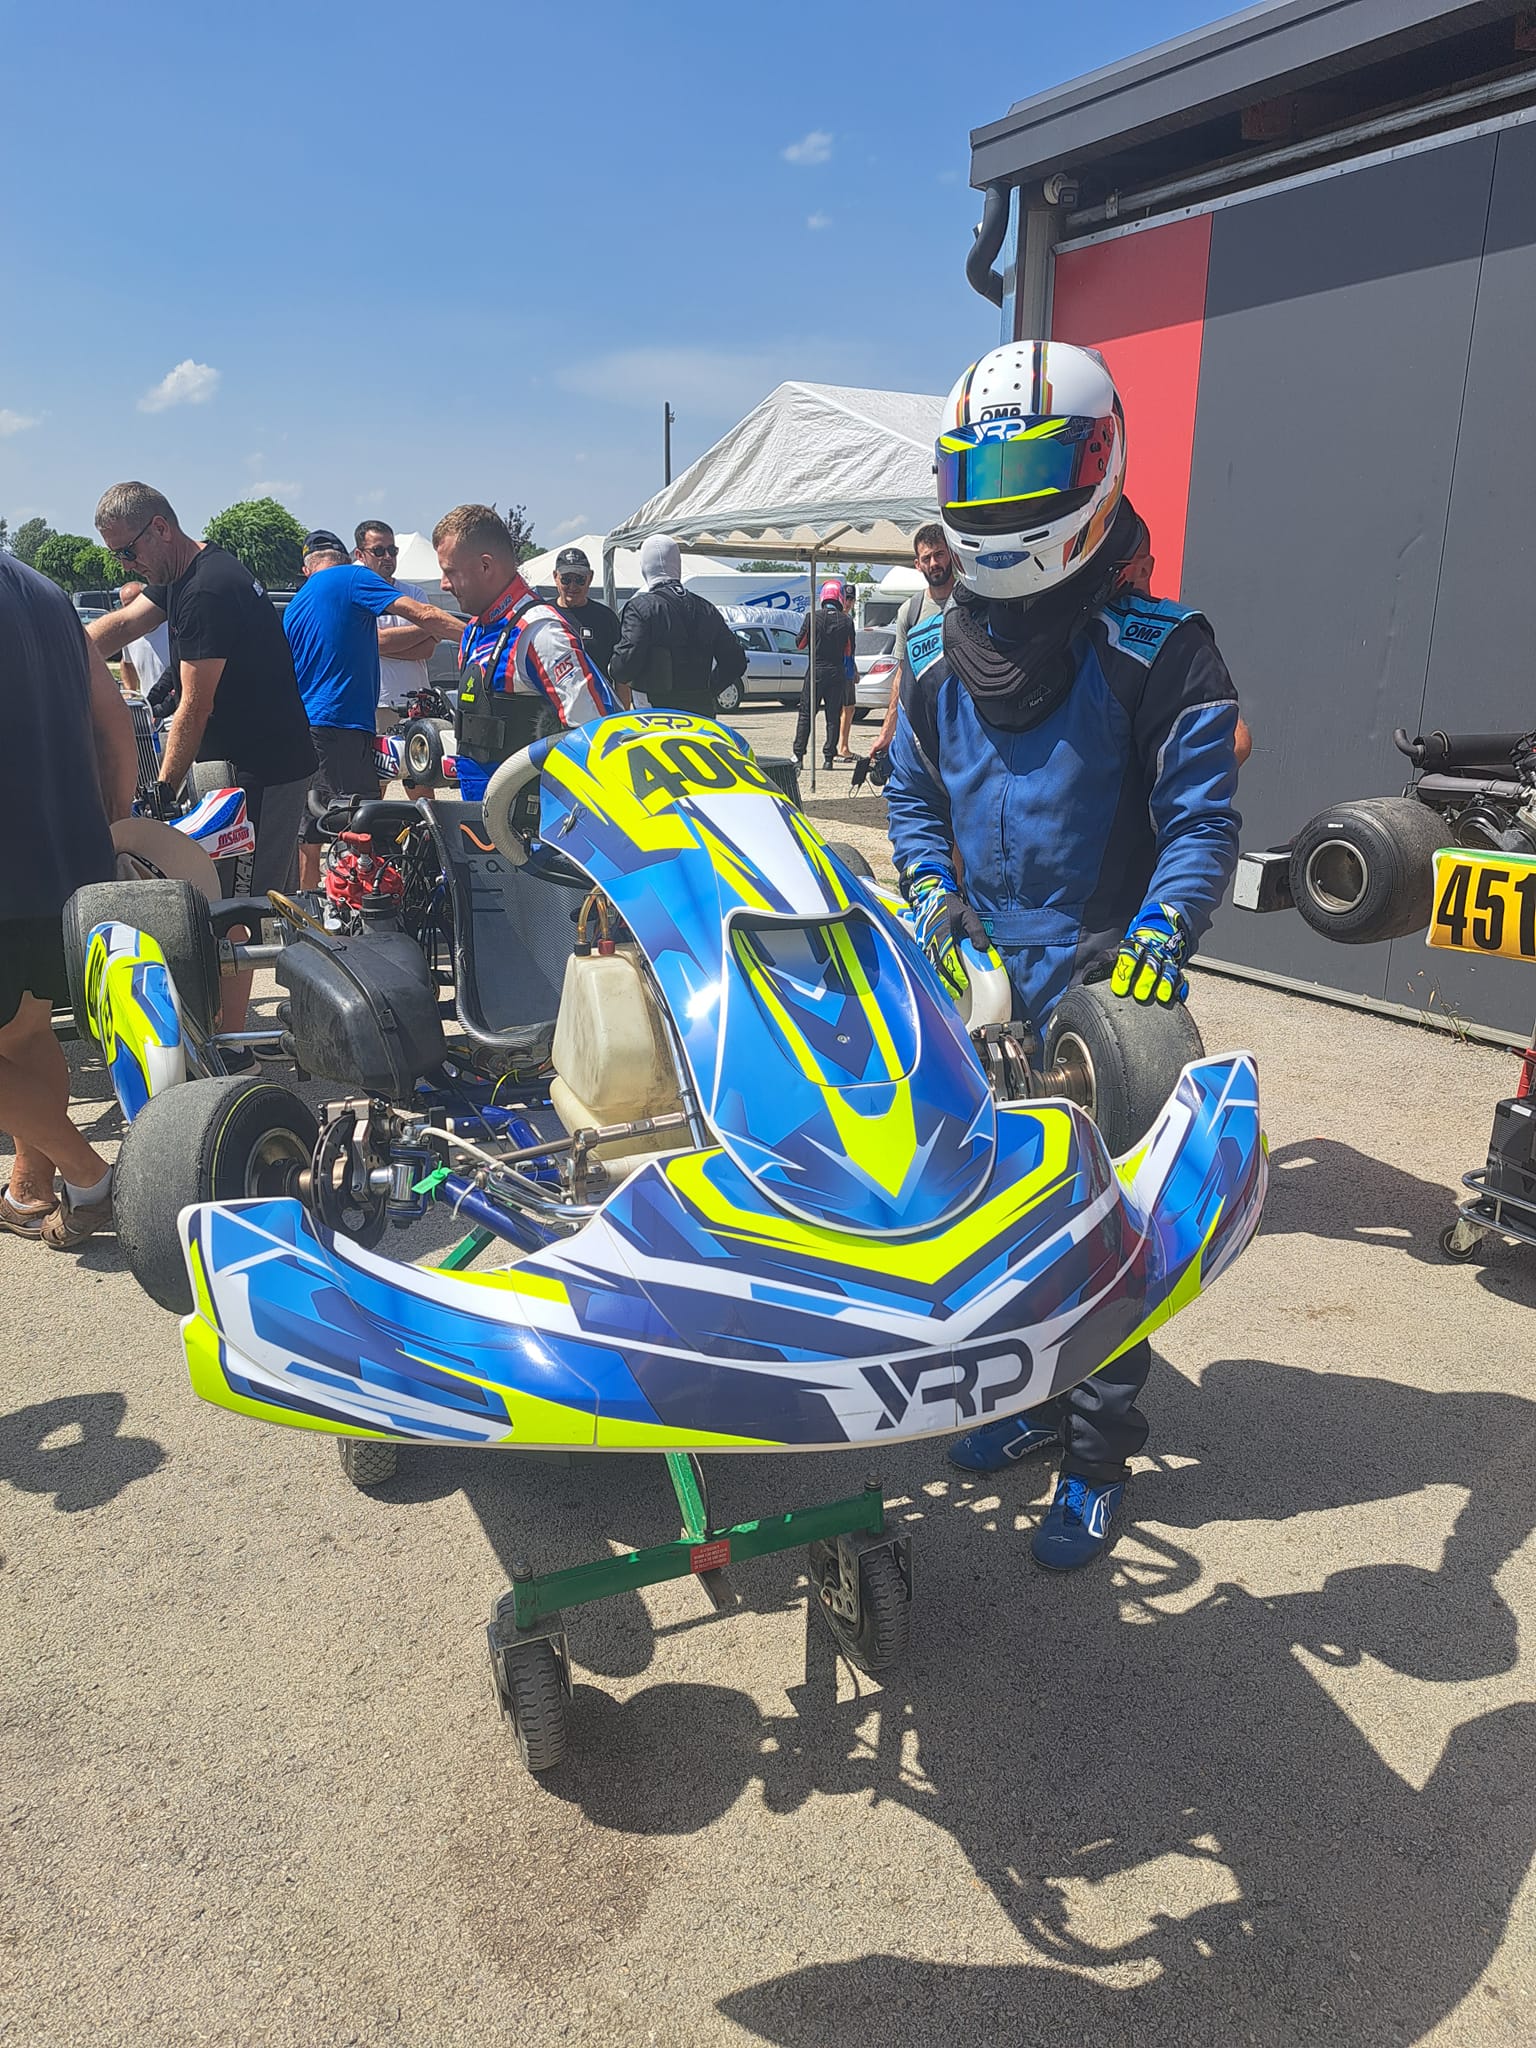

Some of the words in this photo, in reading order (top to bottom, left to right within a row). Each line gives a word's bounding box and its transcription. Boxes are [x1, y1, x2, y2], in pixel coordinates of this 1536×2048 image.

[988, 553, 1014, 562] ROTAX
[1125, 624, 1162, 642] OMP
[911, 636, 940, 658] OMP
[626, 738, 785, 801] 406
[1436, 864, 1536, 957] 451
